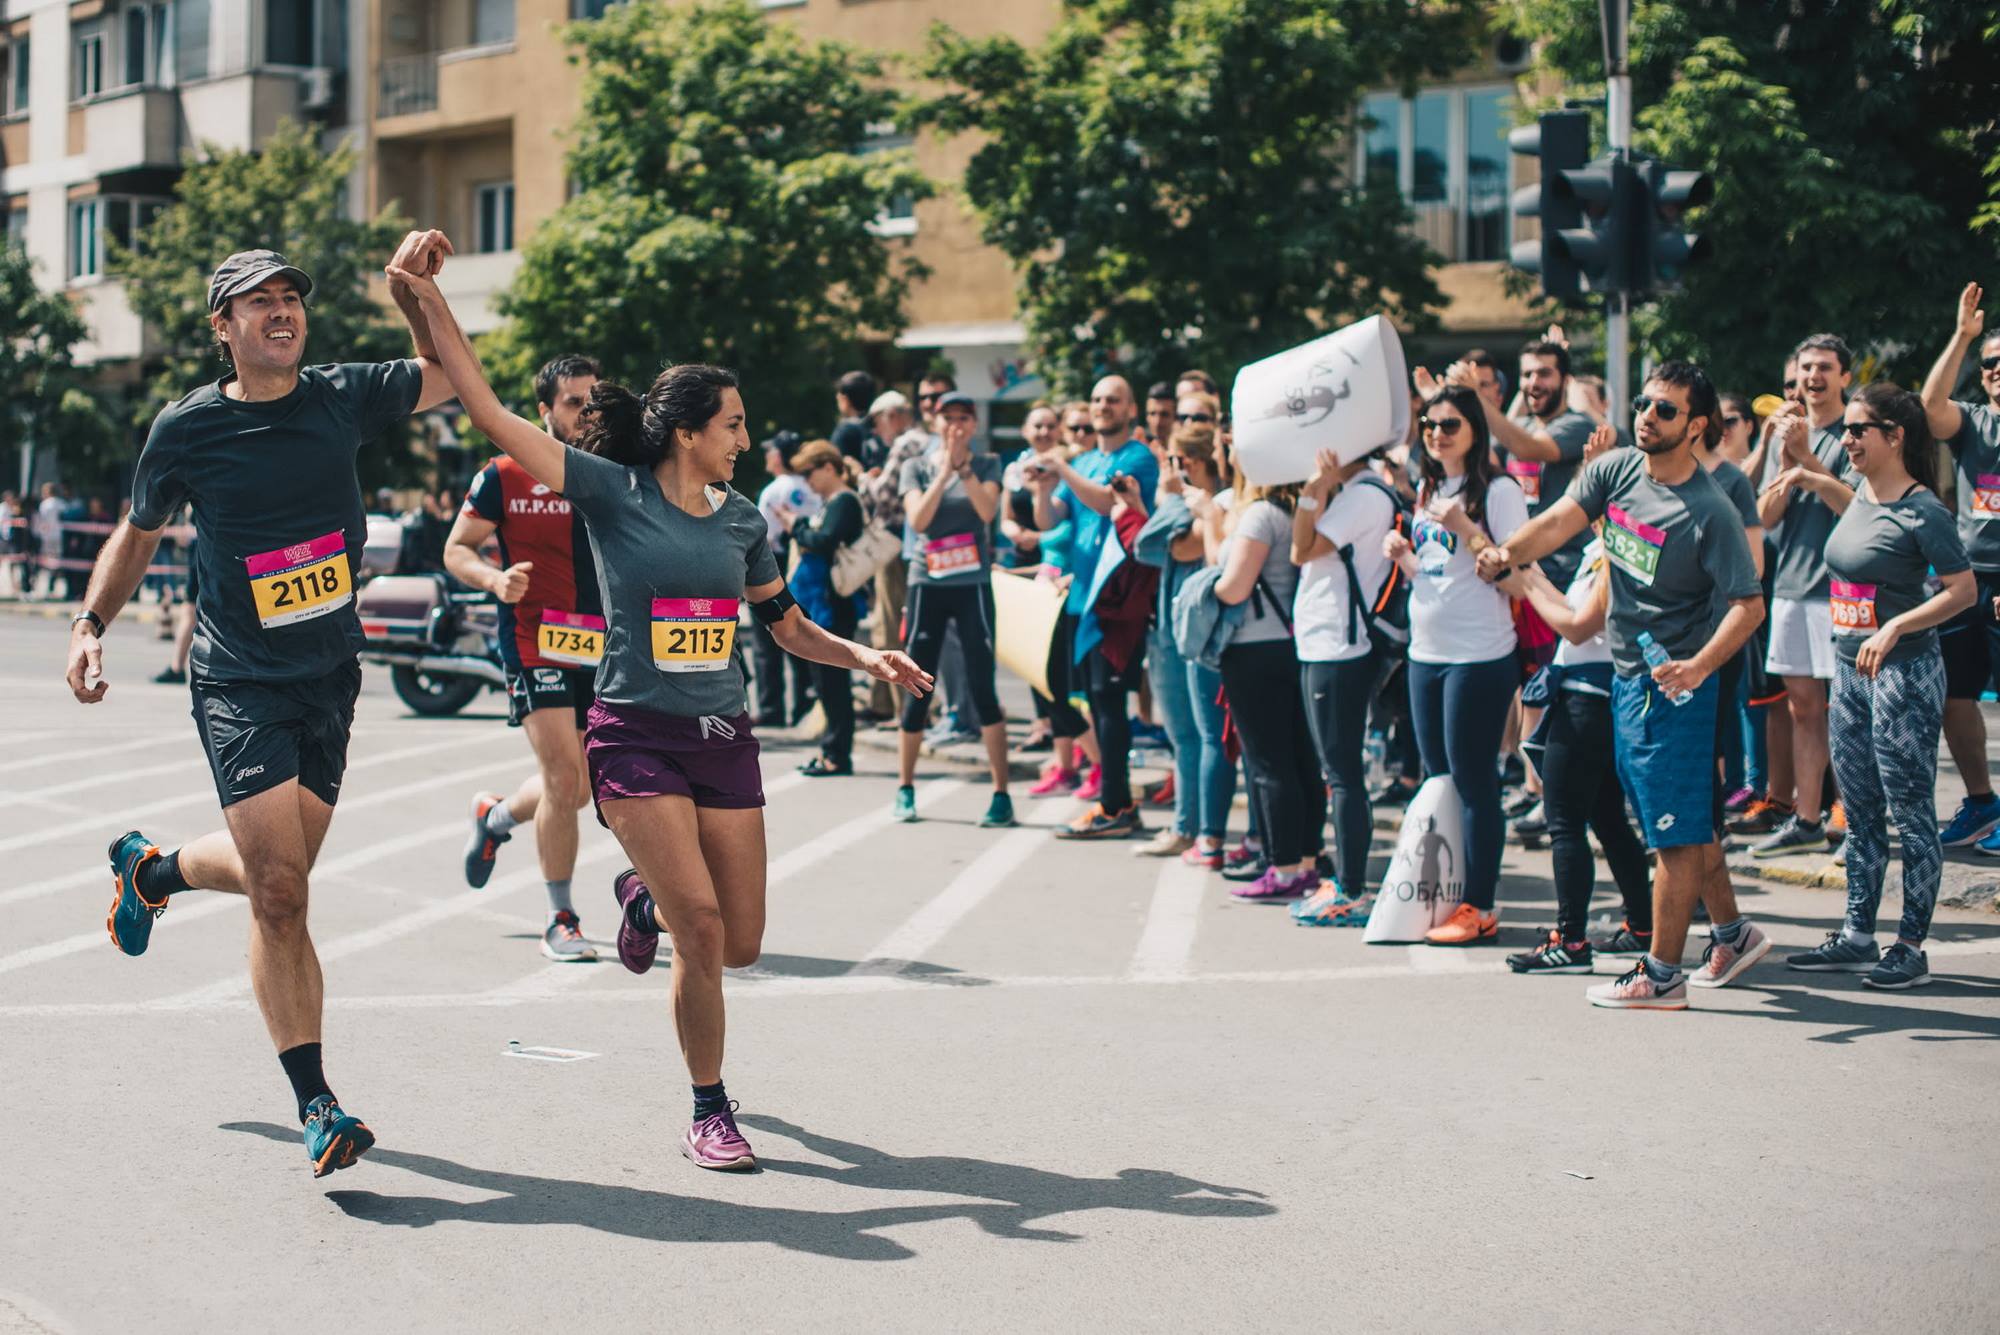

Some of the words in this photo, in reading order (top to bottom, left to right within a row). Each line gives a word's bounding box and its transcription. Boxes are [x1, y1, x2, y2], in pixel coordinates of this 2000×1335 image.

[508, 498, 571, 515] AT.P.CO
[1605, 527, 1655, 571] 562-1
[271, 566, 338, 608] 2118
[547, 630, 595, 653] 1734
[667, 628, 726, 654] 2113
